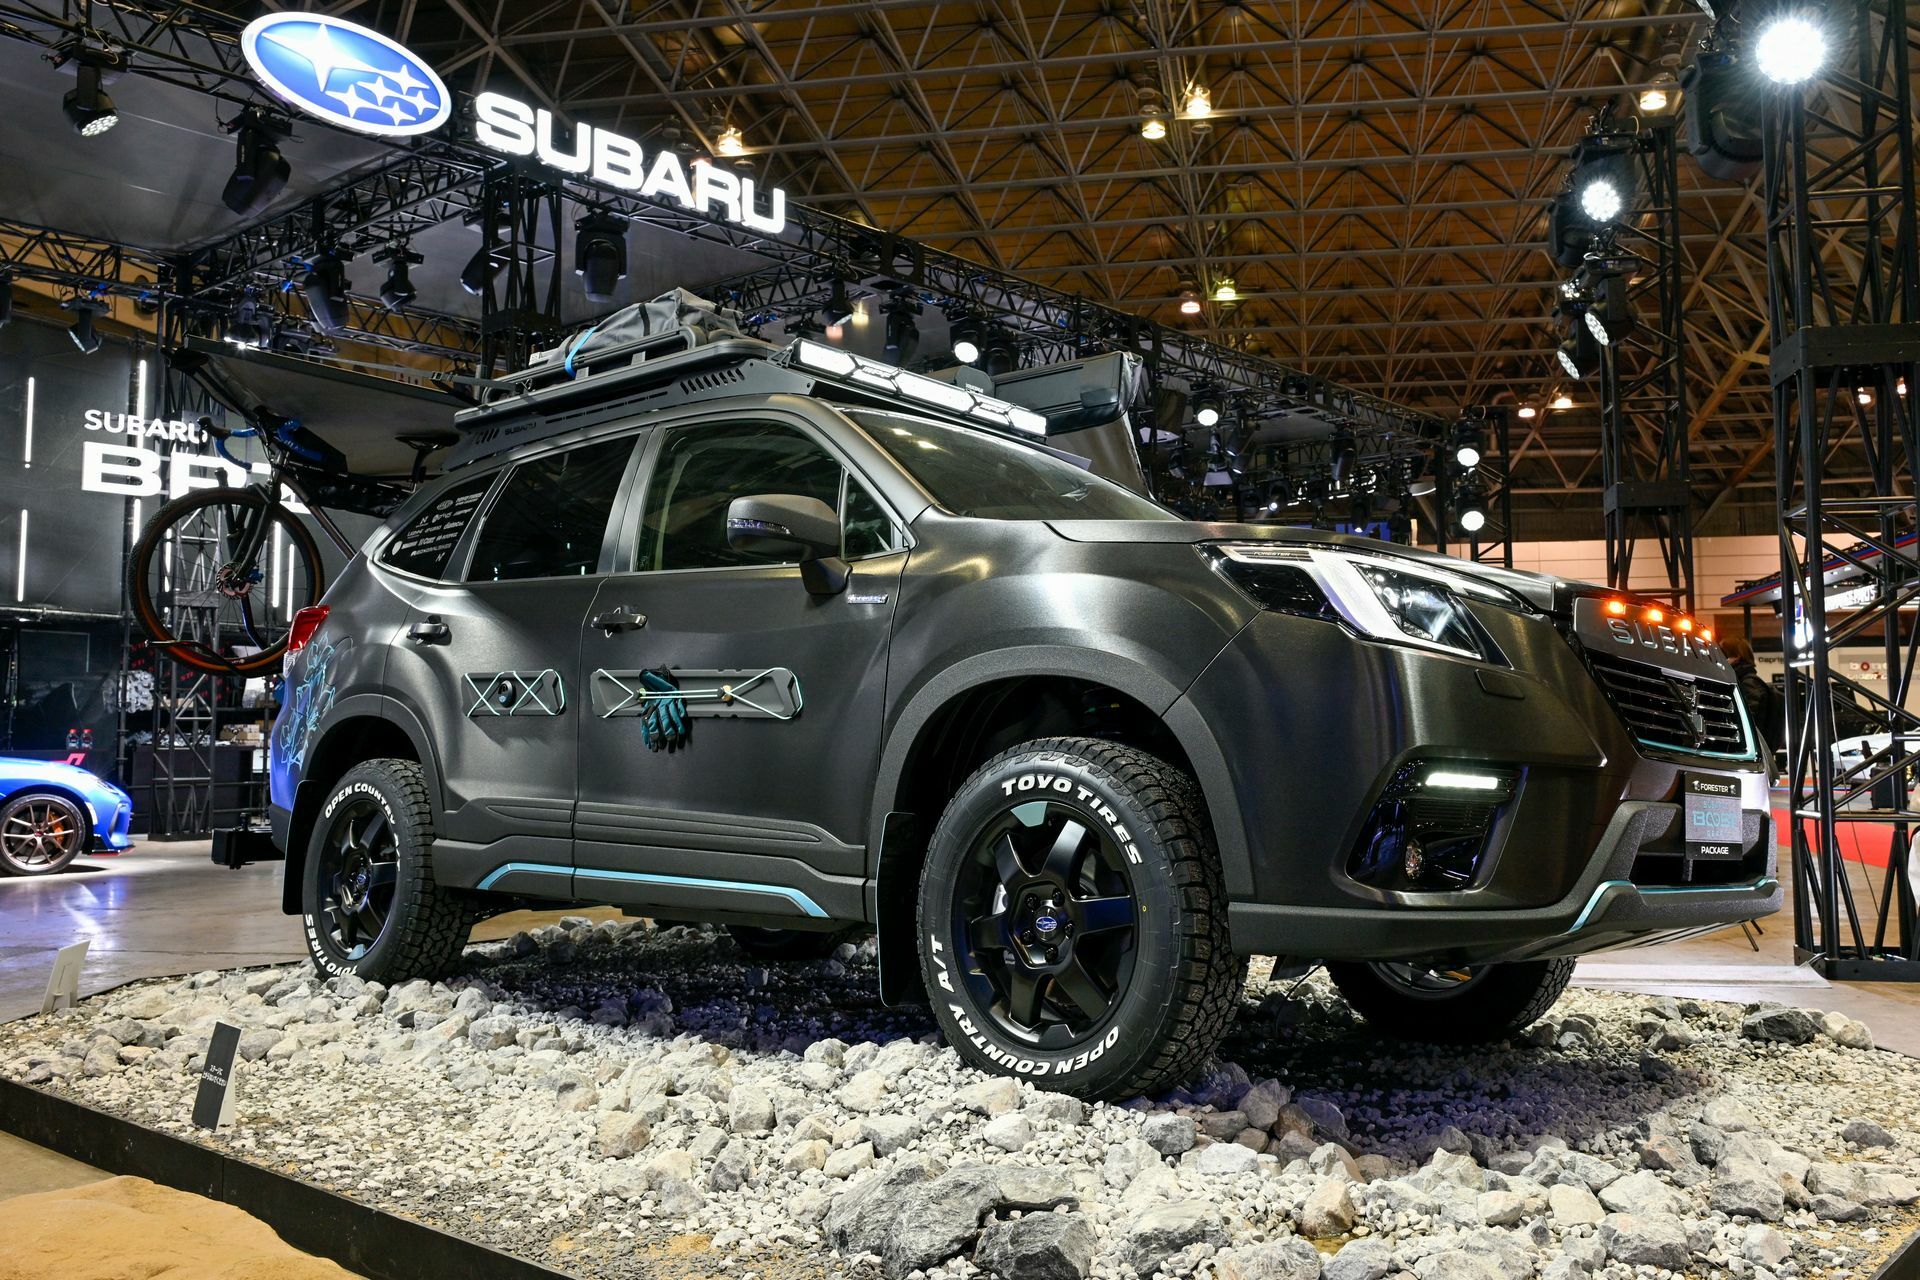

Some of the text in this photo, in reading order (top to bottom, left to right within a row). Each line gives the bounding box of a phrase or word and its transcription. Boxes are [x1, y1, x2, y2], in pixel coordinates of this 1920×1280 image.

[475, 92, 785, 234] SUBARU
[82, 441, 312, 514] BR
[325, 782, 396, 825] OPEN COUNTRY
[1002, 773, 1144, 865] TOYO TIRES
[1700, 783, 1729, 793] FORESTER
[1701, 846, 1729, 855] PACKAGE
[305, 914, 358, 976] TOYO TIRES
[931, 934, 1120, 1077] OPEN COUNTRY A/T
